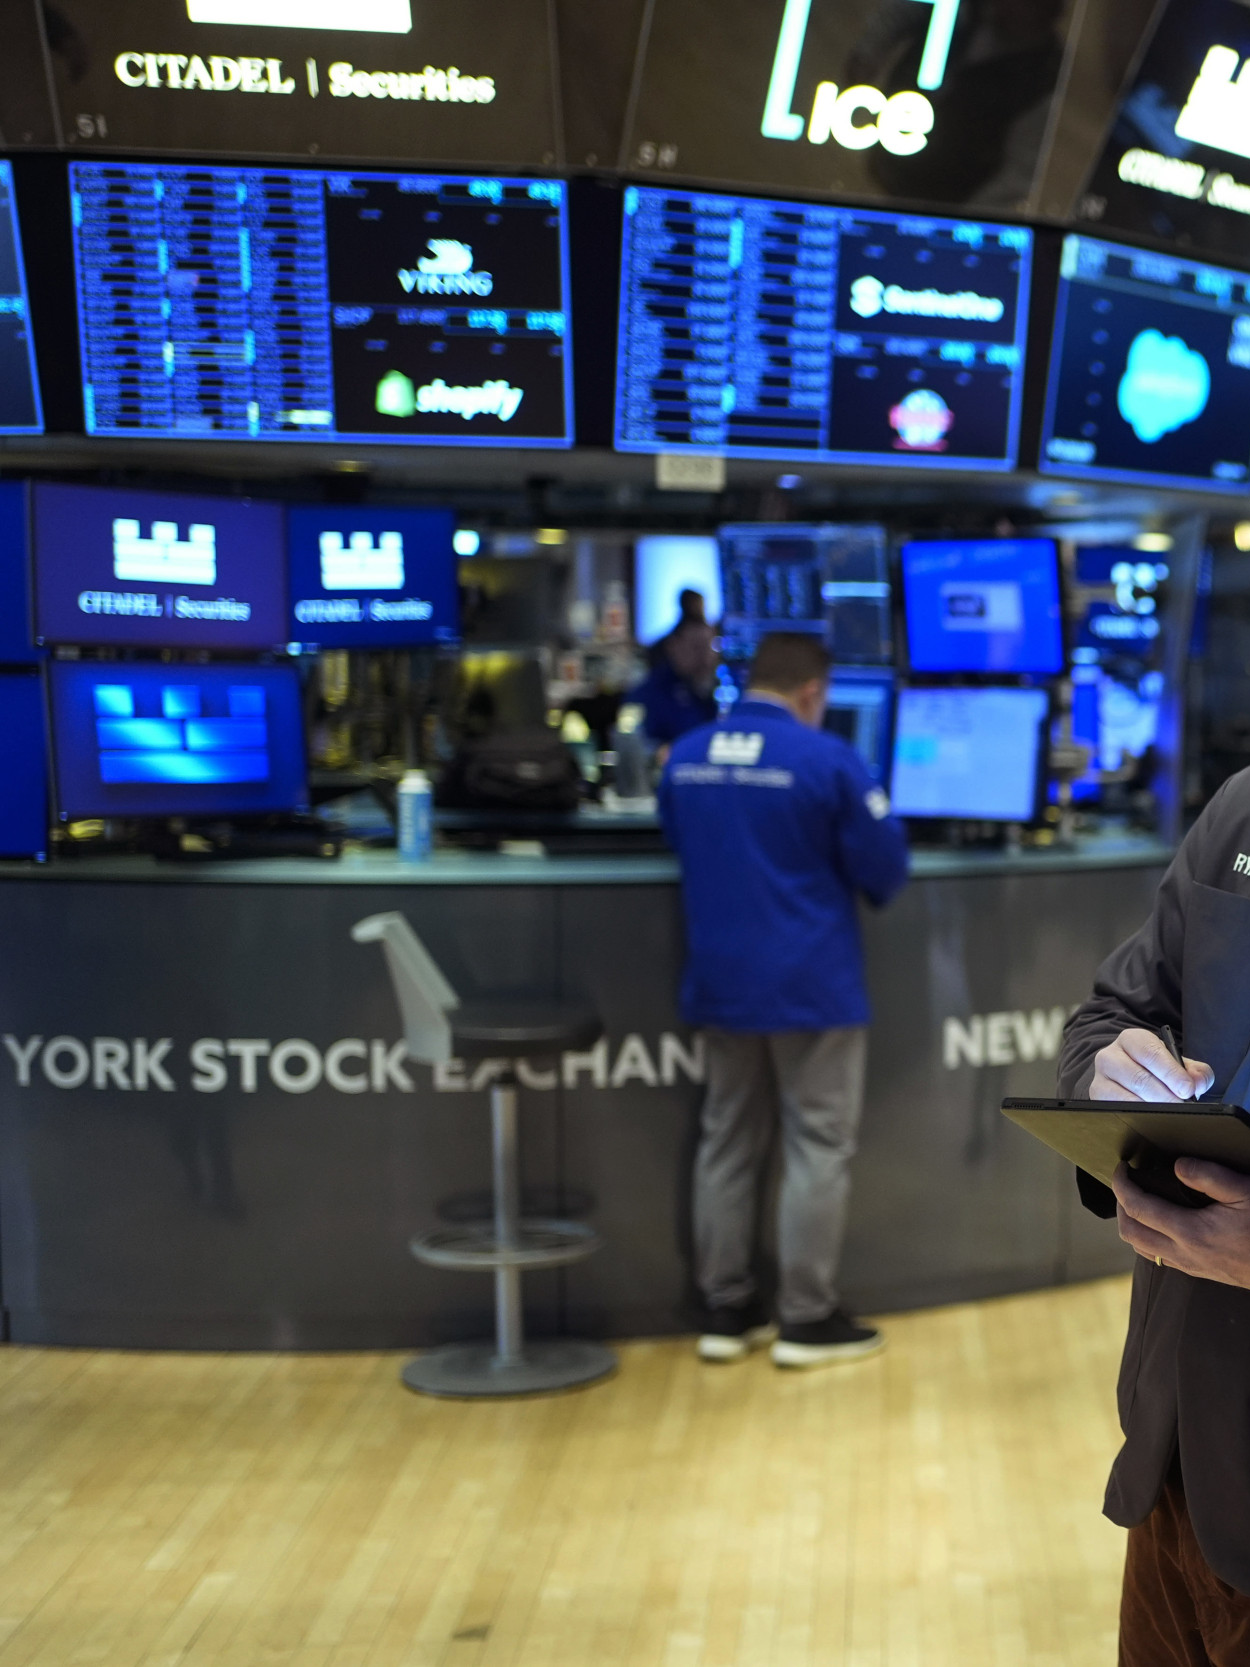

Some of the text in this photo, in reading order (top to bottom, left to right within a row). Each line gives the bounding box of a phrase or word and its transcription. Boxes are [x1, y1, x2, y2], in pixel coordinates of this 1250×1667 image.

[114, 52, 497, 104] CITADEL Securities
[398, 268, 493, 296] VIKING
[78, 590, 163, 617] CITADEL
[2, 1033, 176, 1092] YORK
[189, 1037, 417, 1095] STOCK
[943, 1006, 1066, 1070] NEW
